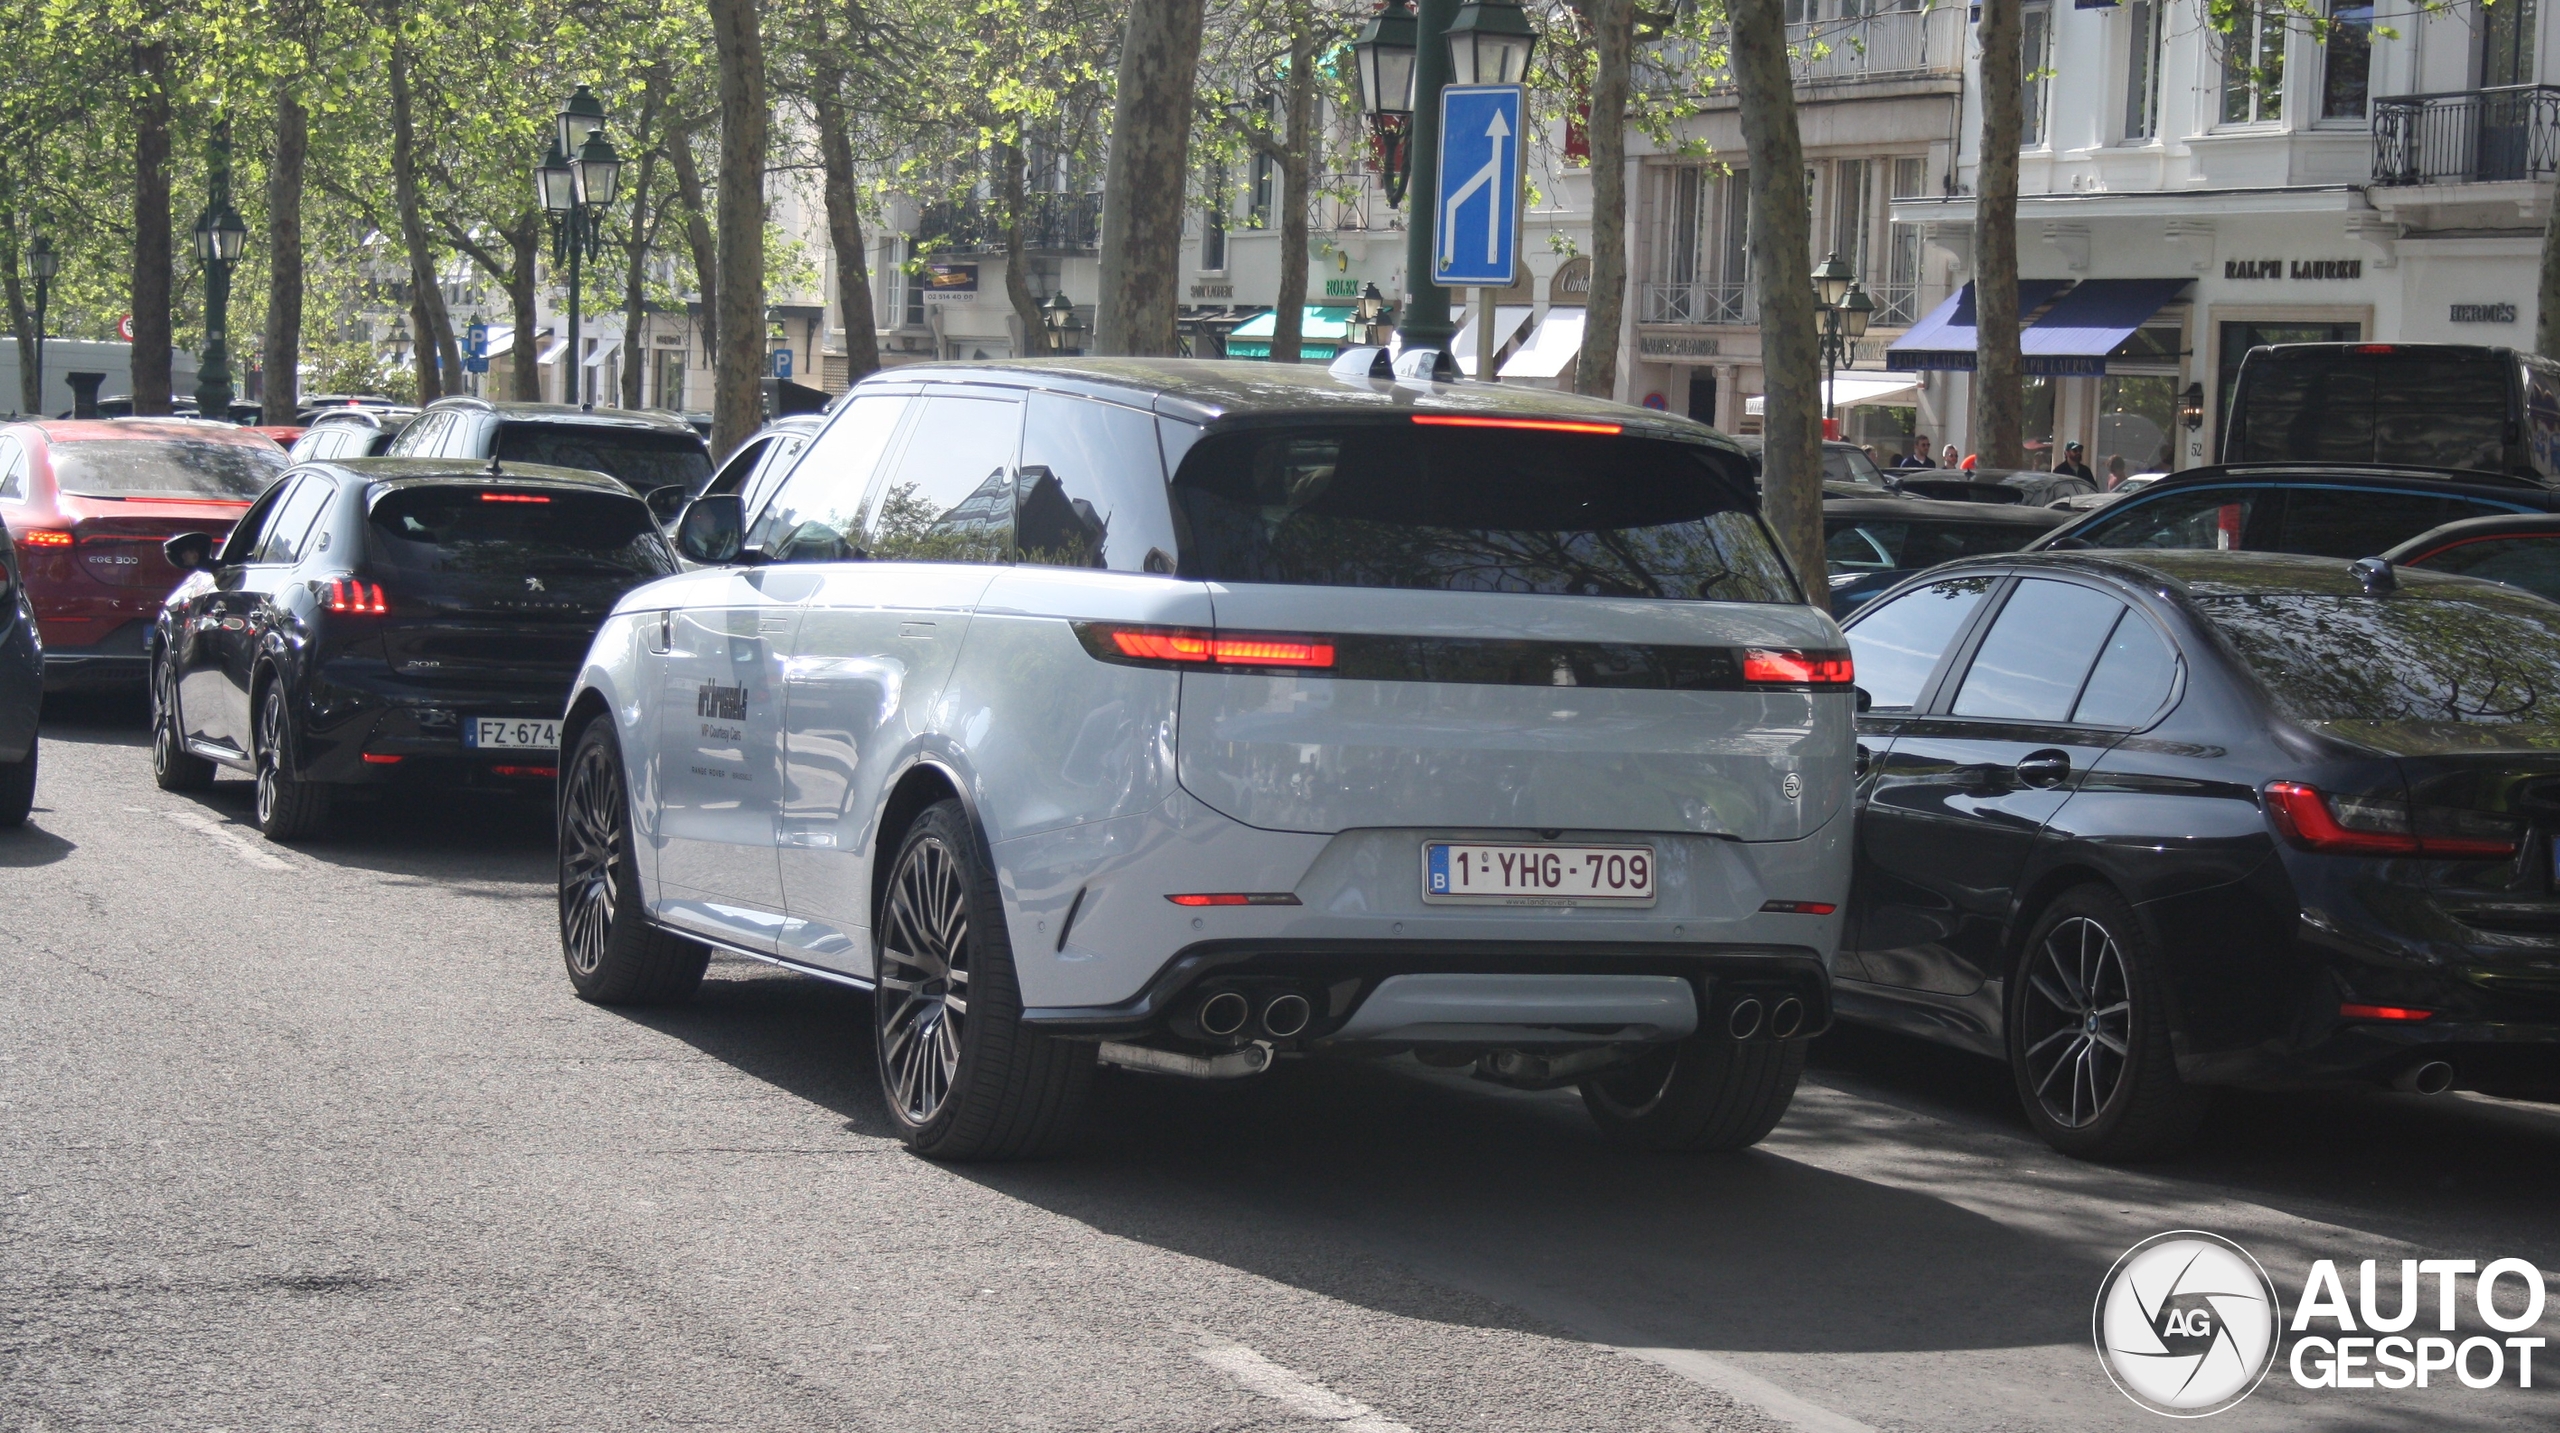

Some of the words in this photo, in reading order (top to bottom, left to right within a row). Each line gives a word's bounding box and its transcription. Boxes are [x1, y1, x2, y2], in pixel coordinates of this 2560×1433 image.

[2224, 260, 2282, 279] RALPH
[2289, 260, 2361, 279] LAUREN
[1326, 279, 1359, 296] ROLEX
[1561, 270, 1590, 292] Cartie
[2449, 302, 2515, 322] HERMÈS
[470, 329, 486, 351] P
[776, 353, 790, 373] P
[1895, 354, 1929, 368] RALPH
[1934, 354, 1975, 368] LAUREN
[2023, 358, 2044, 373] LPH
[2050, 359, 2094, 374] LAUREN
[2191, 442, 2202, 457] 52
[88, 556, 113, 564] EQE
[115, 556, 139, 564] 300
[494, 600, 582, 609] PEUGEOT
[481, 722, 561, 745] FZ-674-
[710, 724, 729, 743] Courtesy
[730, 726, 741, 741] Cars
[691, 766, 707, 775] RANGE
[708, 768, 725, 777] ROVER
[732, 772, 753, 781] BRUSSELS
[1457, 851, 1648, 890] 1-YHG-709
[1433, 873, 1446, 889] B
[1505, 897, 1578, 907] www.landrover.be
